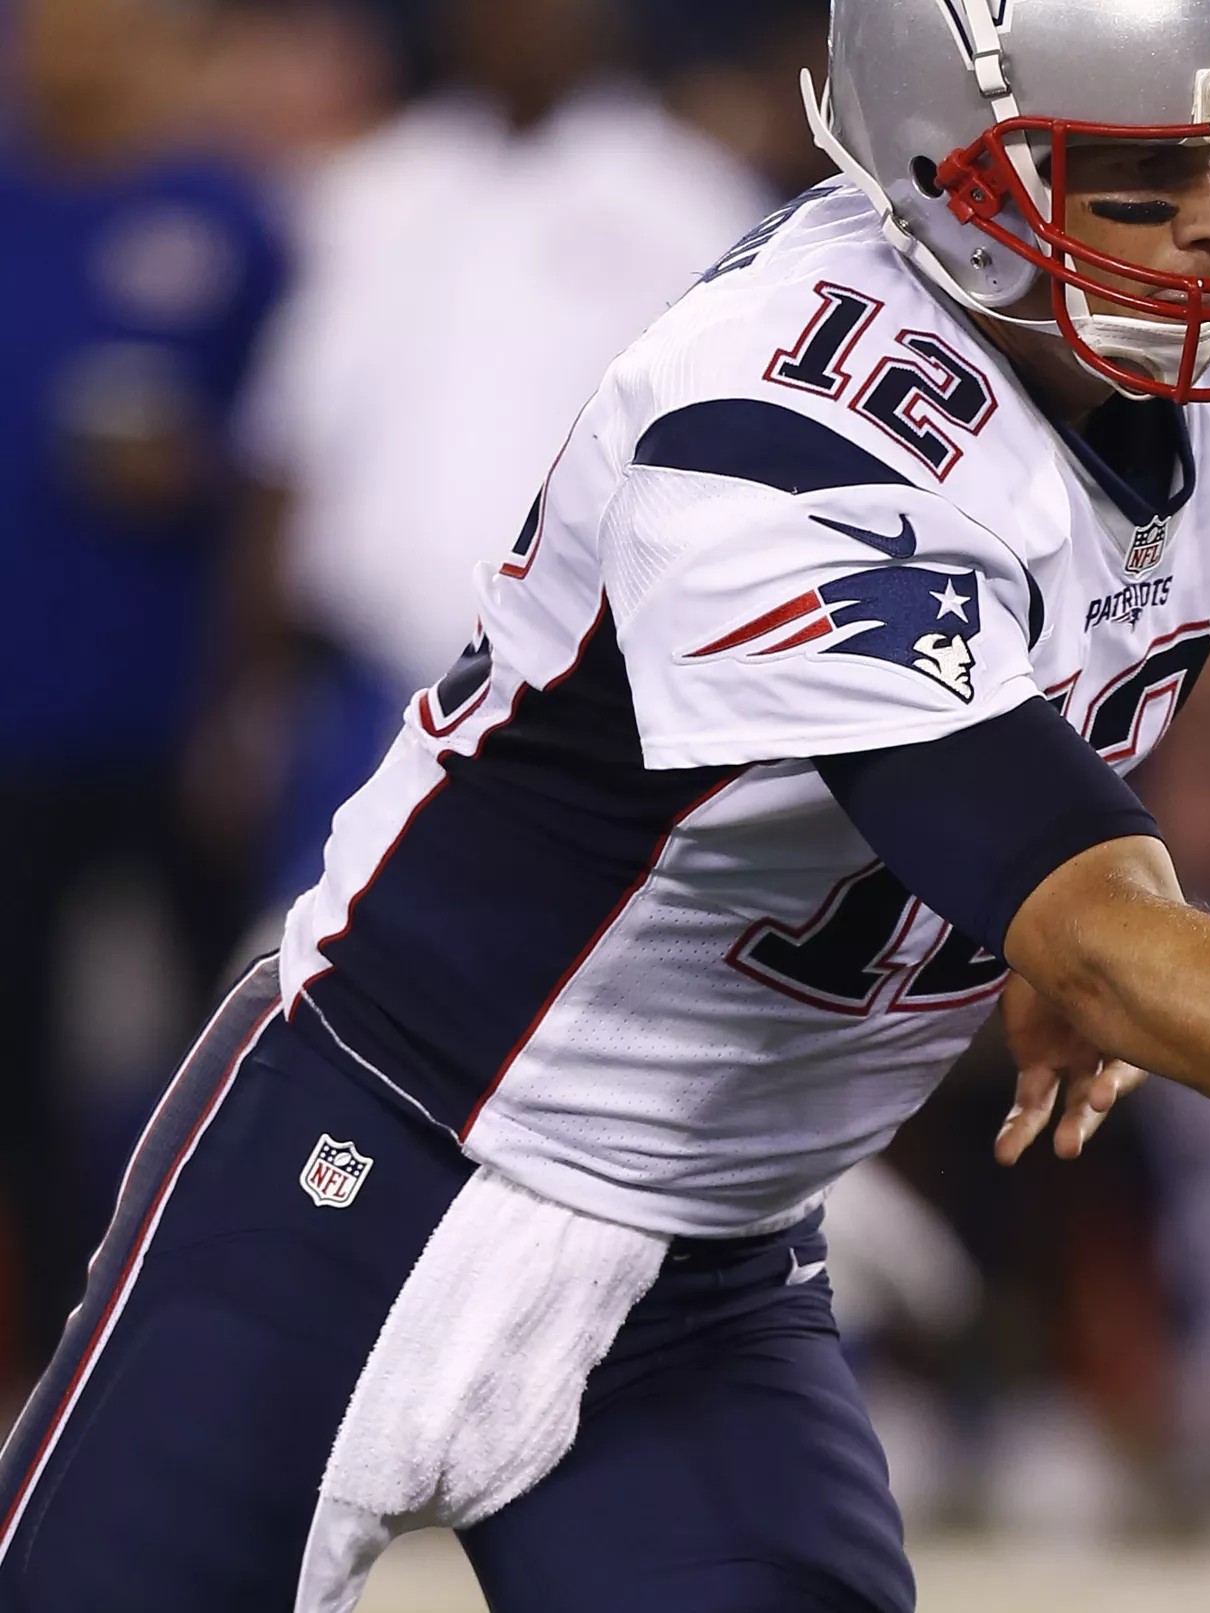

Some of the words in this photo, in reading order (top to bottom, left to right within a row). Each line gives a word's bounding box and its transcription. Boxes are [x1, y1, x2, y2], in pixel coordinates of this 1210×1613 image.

[762, 281, 998, 482] 12
[1128, 544, 1161, 569] NFL
[1084, 575, 1174, 634] PATRIOTS
[310, 1161, 349, 1198] NFL
